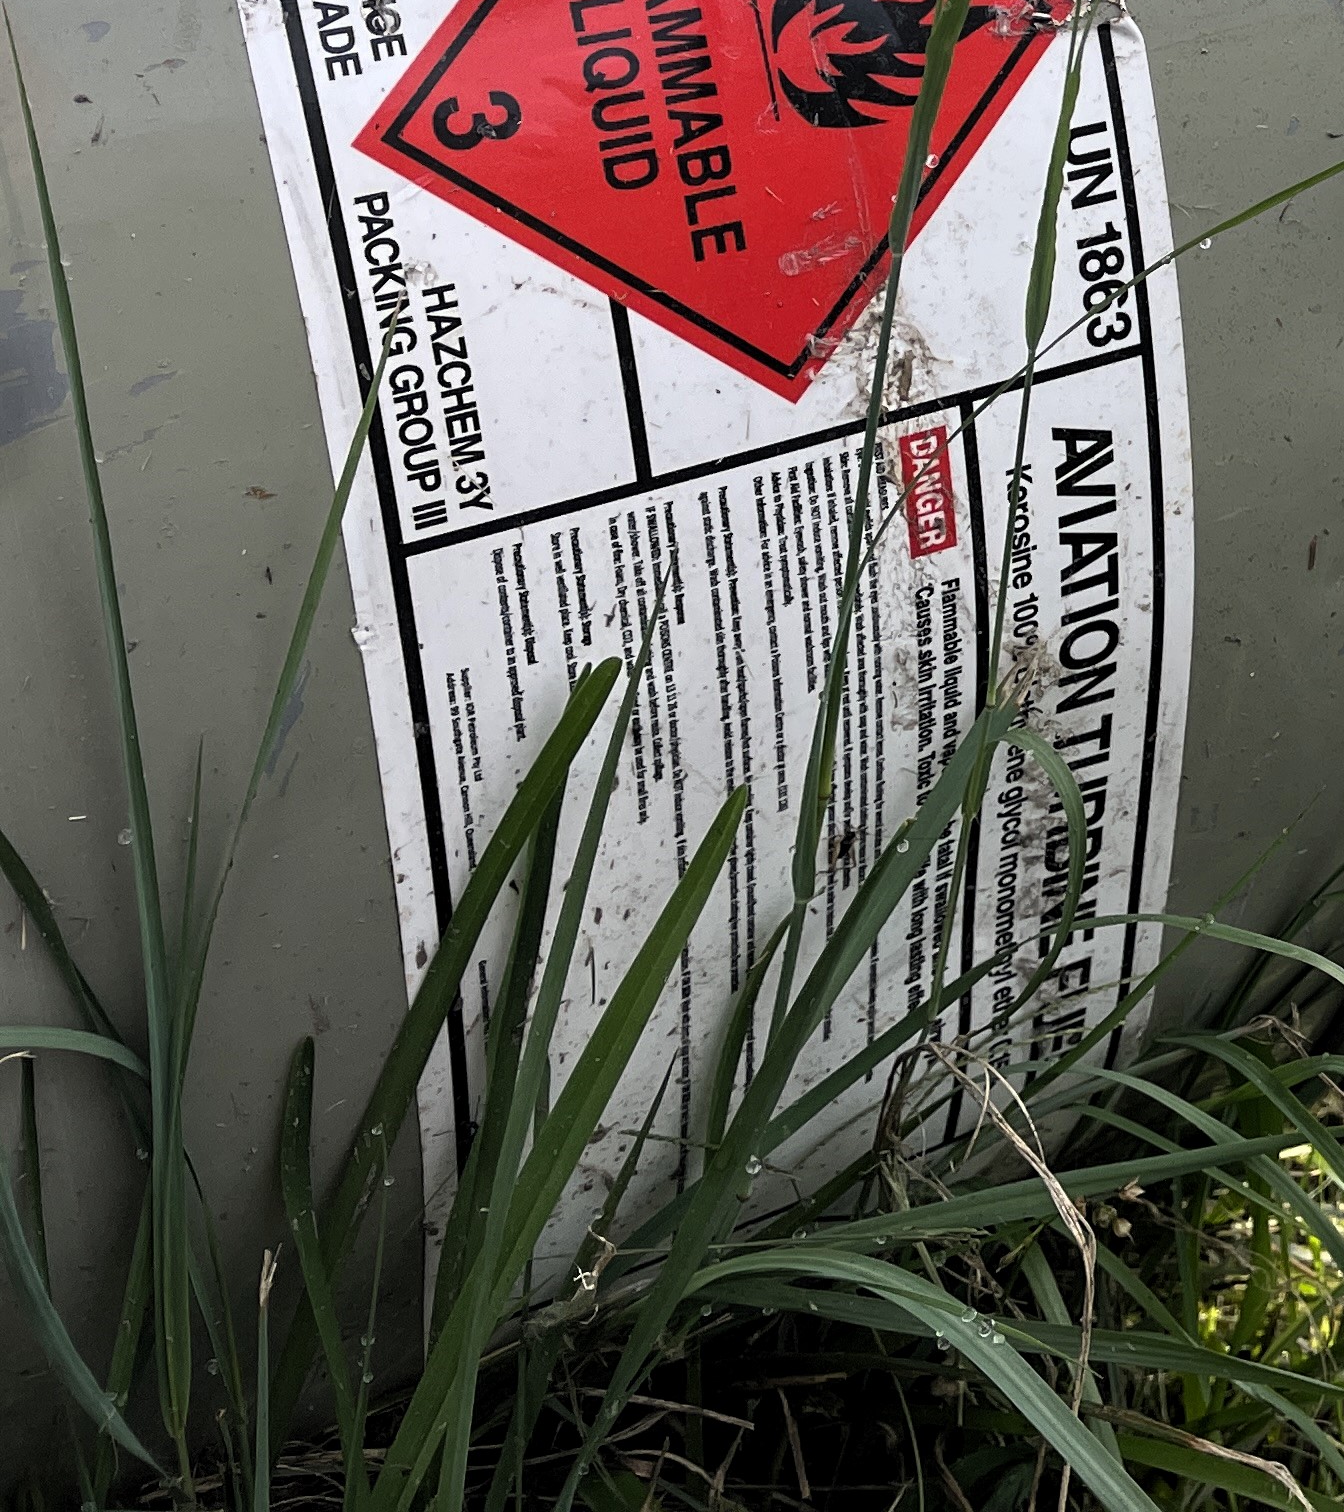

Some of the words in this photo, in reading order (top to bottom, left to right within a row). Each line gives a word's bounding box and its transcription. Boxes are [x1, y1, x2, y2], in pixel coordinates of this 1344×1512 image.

[432, 89, 523, 152] 3
[1067, 122, 1118, 210] UN
[353, 192, 417, 358] PACKING
[1076, 222, 1132, 348] 1863
[422, 284, 485, 464] HAZCHEM
[454, 472, 494, 511] 3Y
[388, 364, 442, 492] GROUP
[910, 435, 946, 550] DANGER
[412, 500, 448, 530] III
[1006, 464, 1038, 590] Kerosine
[1052, 428, 1120, 714] AVIATION
[915, 586, 934, 648] Causes
[941, 578, 962, 665] Flammable
[460, 668, 472, 702] Supplier:
[918, 650, 936, 684] skin
[446, 673, 456, 706] Address:
[939, 666, 962, 710] liquid
[450, 705, 460, 716] 99
[918, 684, 936, 753] irritation.
[943, 712, 960, 739] and
[452, 716, 464, 755] Southgate
[468, 717, 478, 756] Petroleum
[471, 756, 482, 770] Pty
[474, 770, 484, 782] Ltd
[918, 752, 936, 790] Toxic
[460, 785, 470, 812] Cannon
[916, 790, 933, 806] to
[996, 786, 1028, 850] glycol
[936, 840, 955, 870] fatal
[912, 879, 929, 909] with
[906, 907, 928, 940] long
[904, 937, 926, 986] lasting
